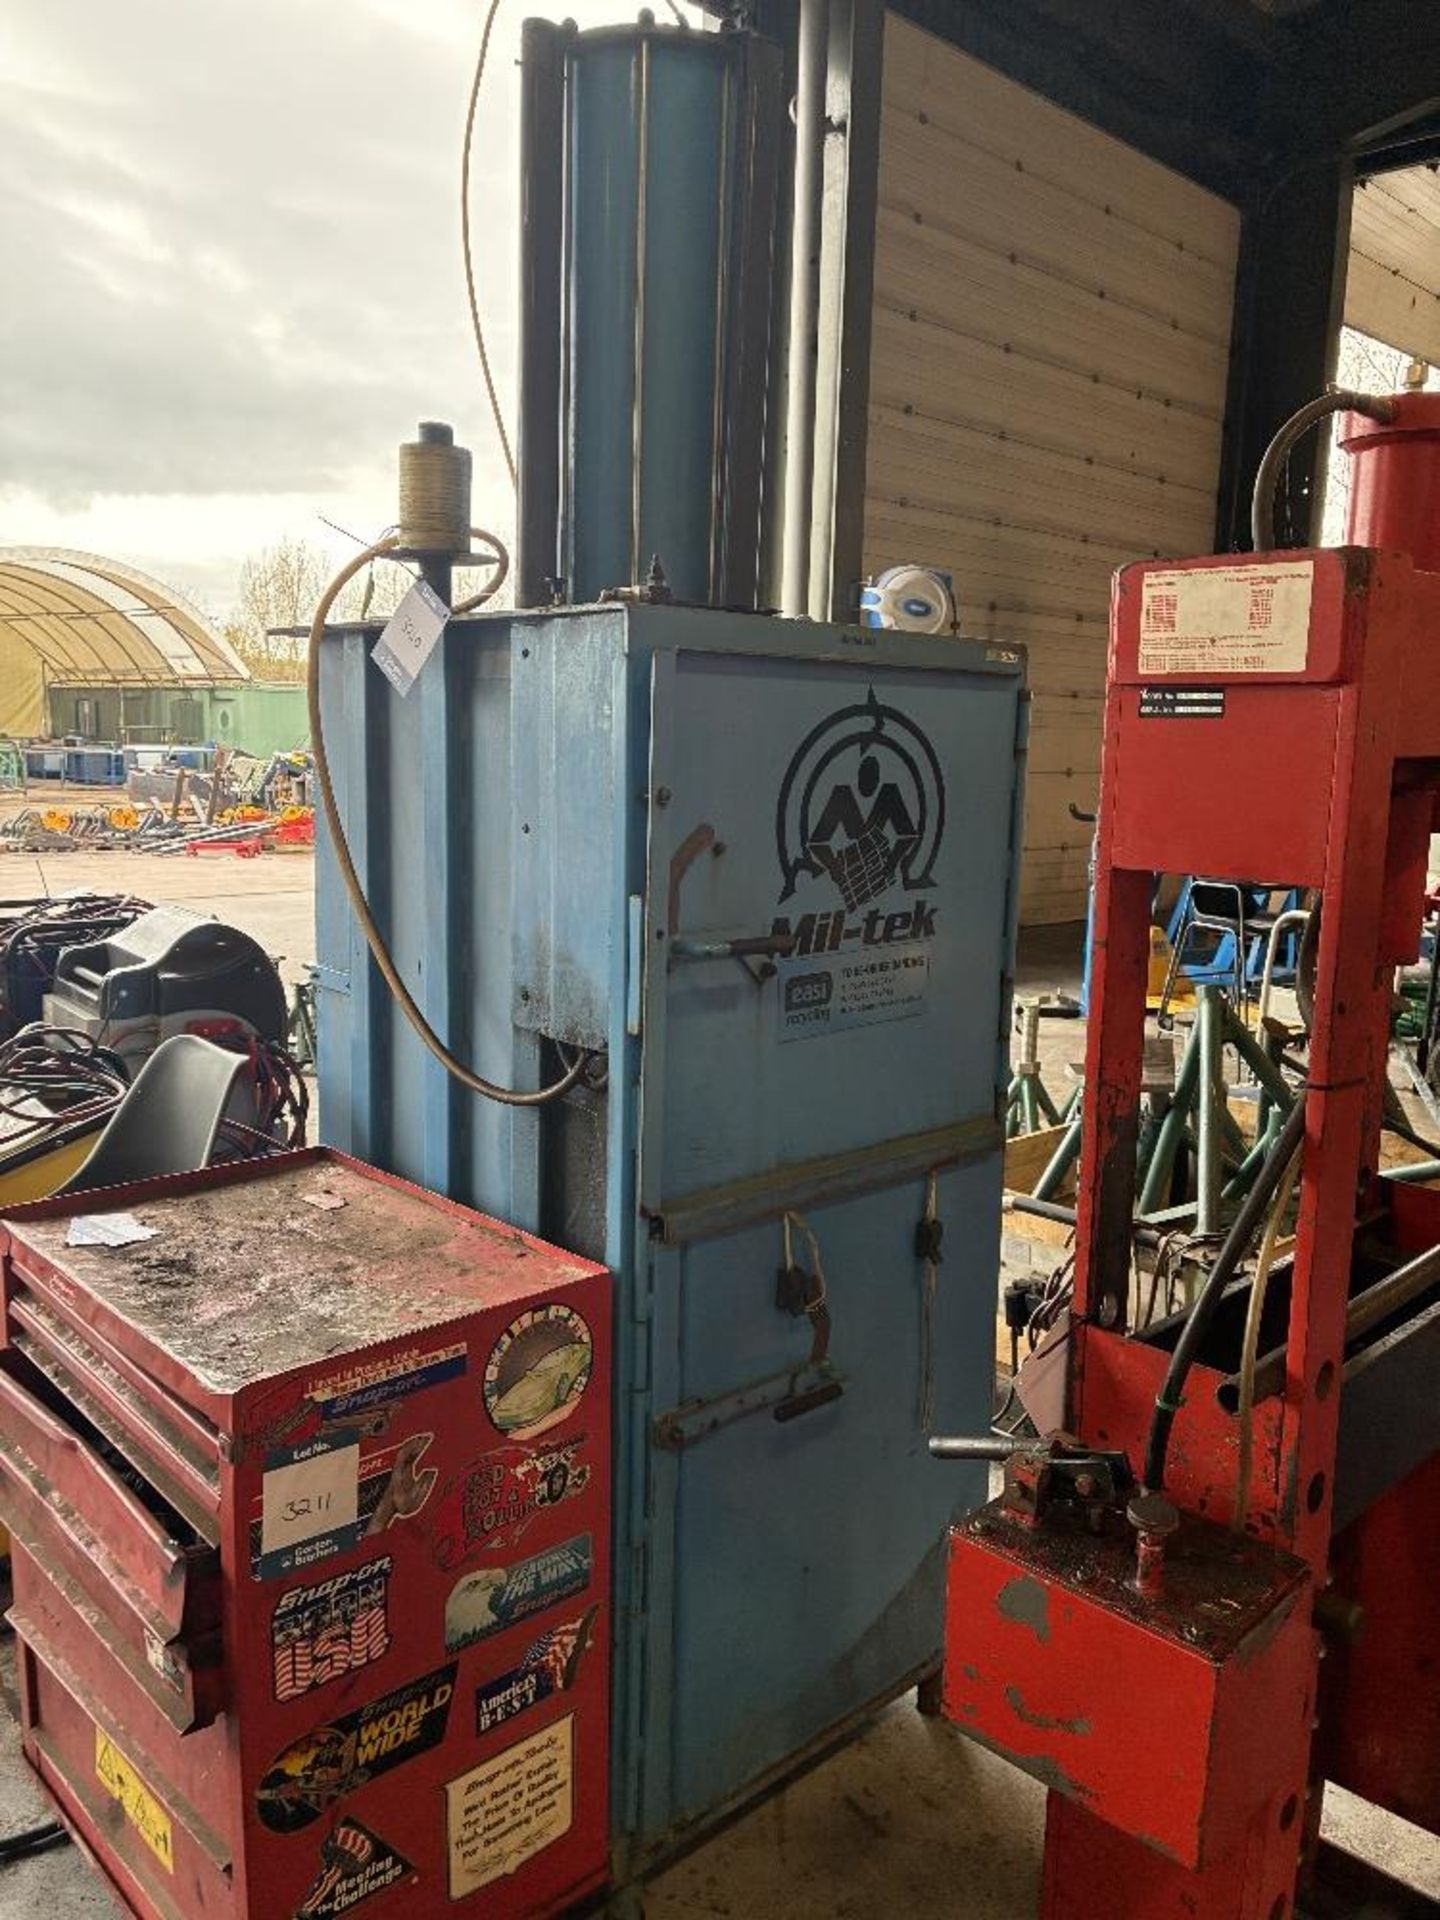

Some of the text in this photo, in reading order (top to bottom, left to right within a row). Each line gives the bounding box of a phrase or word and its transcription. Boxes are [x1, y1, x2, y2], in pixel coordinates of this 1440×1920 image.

[771, 900, 938, 957] Mil-tek
[282, 1491, 332, 1522] 3211
[273, 1556, 394, 1617] Snap-on
[275, 1606, 387, 1702] USA
[359, 1683, 453, 1746] WORLD
[356, 1719, 423, 1768] WIDE
[332, 1864, 403, 1912] Challenge
[335, 1855, 394, 1897] Meeting
